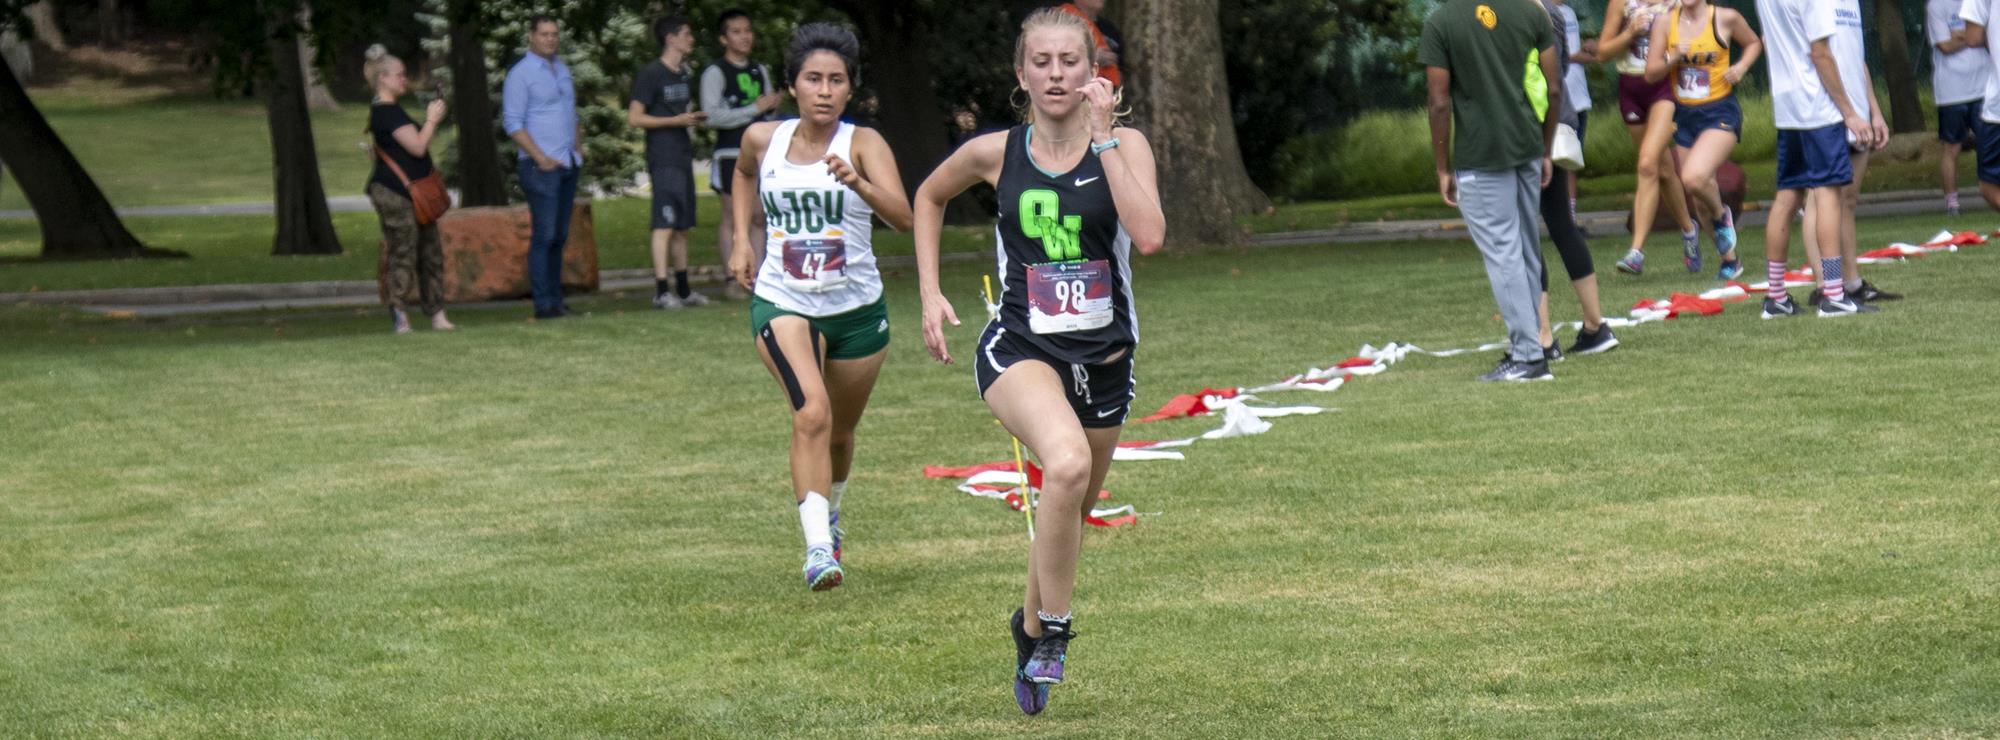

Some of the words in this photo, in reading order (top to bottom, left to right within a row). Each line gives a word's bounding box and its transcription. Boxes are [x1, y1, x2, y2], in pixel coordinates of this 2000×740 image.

[762, 190, 844, 234] NJCU
[802, 252, 826, 279] 47
[1055, 280, 1086, 312] 98
